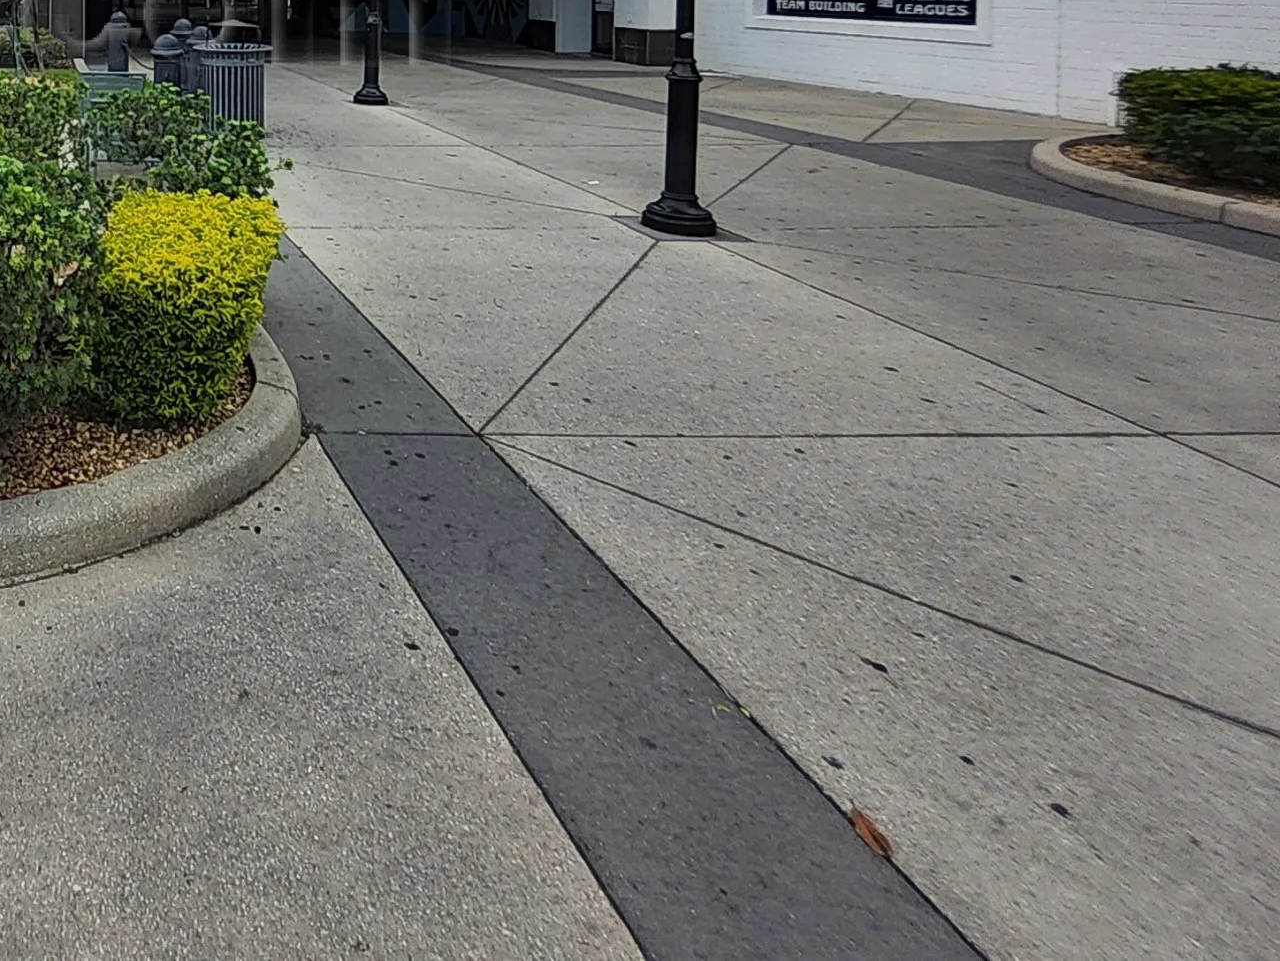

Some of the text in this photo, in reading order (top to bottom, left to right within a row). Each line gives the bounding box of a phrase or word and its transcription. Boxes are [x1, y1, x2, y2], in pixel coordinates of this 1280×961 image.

[775, 0, 866, 12] TEAM BUILDING
[895, 4, 969, 16] LEAGUES
